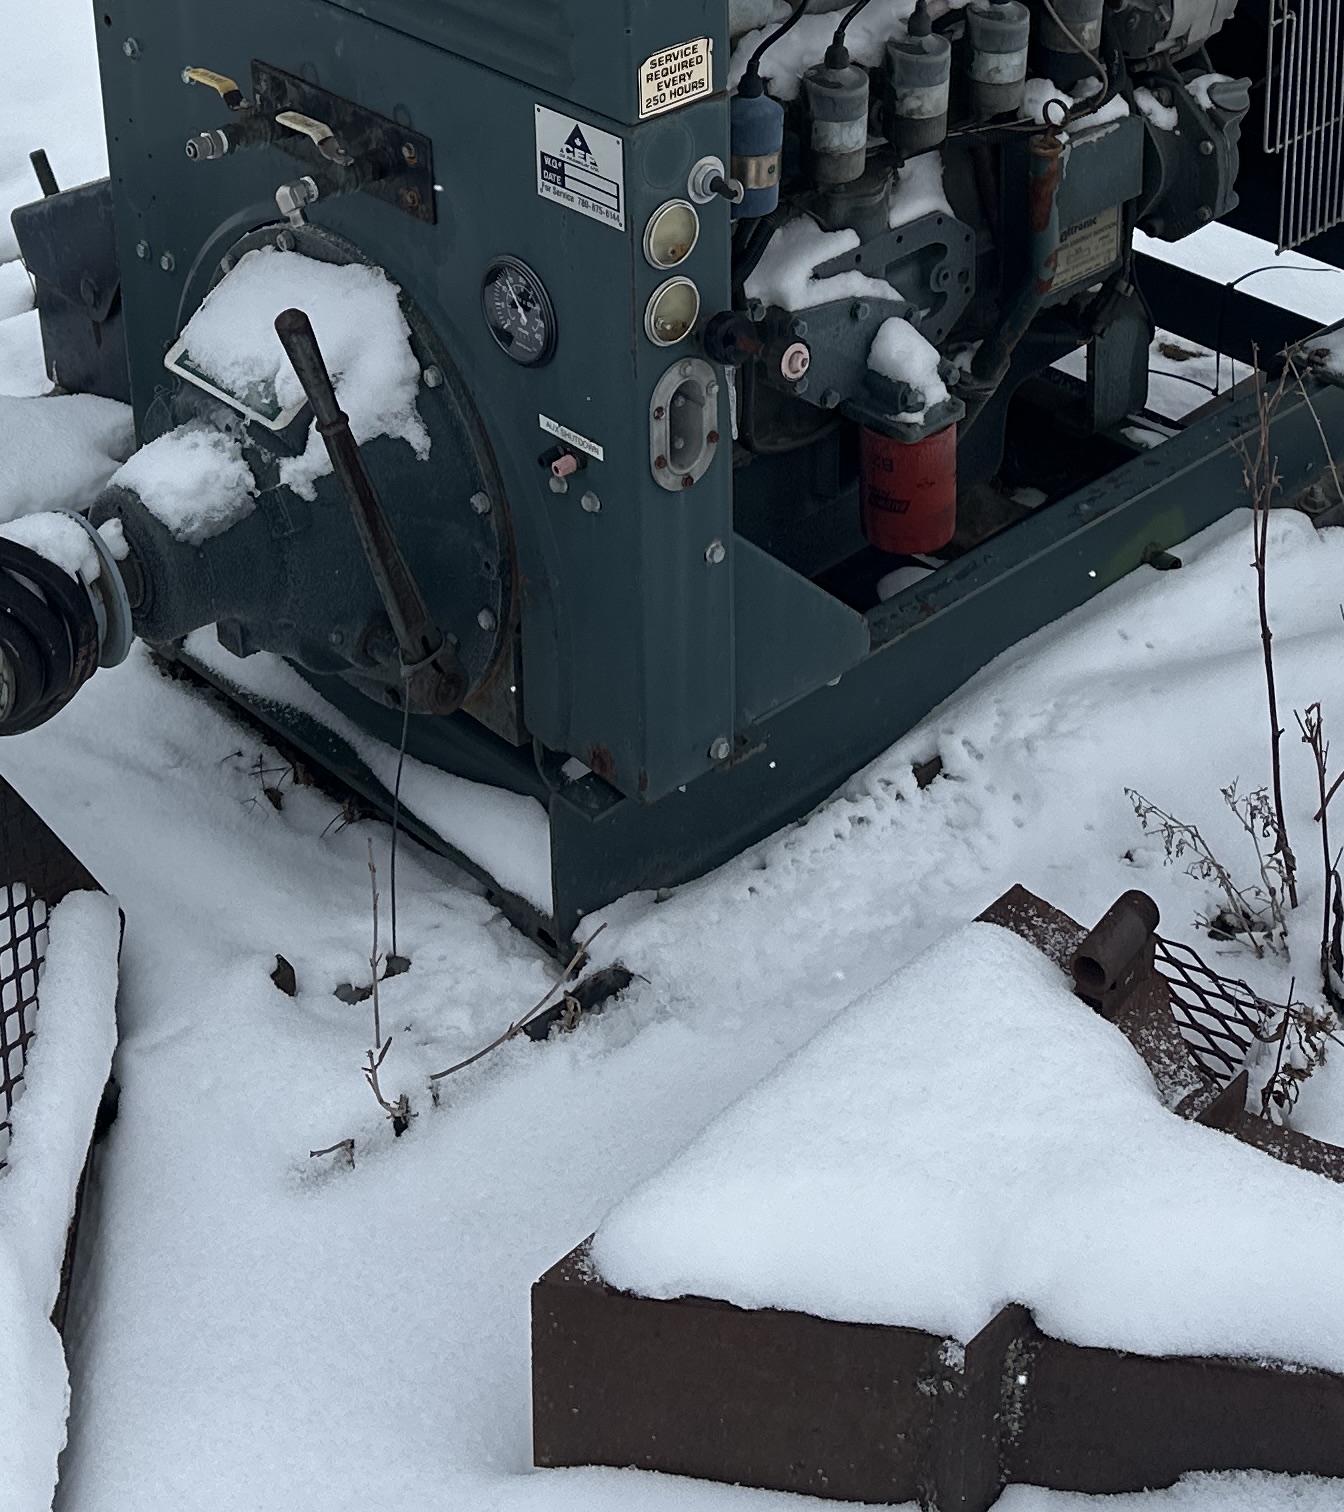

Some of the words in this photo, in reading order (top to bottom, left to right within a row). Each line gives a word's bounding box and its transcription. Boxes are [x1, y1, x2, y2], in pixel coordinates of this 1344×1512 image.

[646, 54, 703, 84] REQUIRED
[649, 43, 699, 70] SERVICE
[645, 92, 666, 109] 250
[669, 78, 705, 100] HOURS
[656, 70, 694, 92] EVERY
[543, 169, 562, 184] DATE
[541, 181, 551, 193] For
[552, 187, 575, 203] Service
[546, 420, 559, 434] AUX
[560, 428, 599, 455] SHUTDOWN
